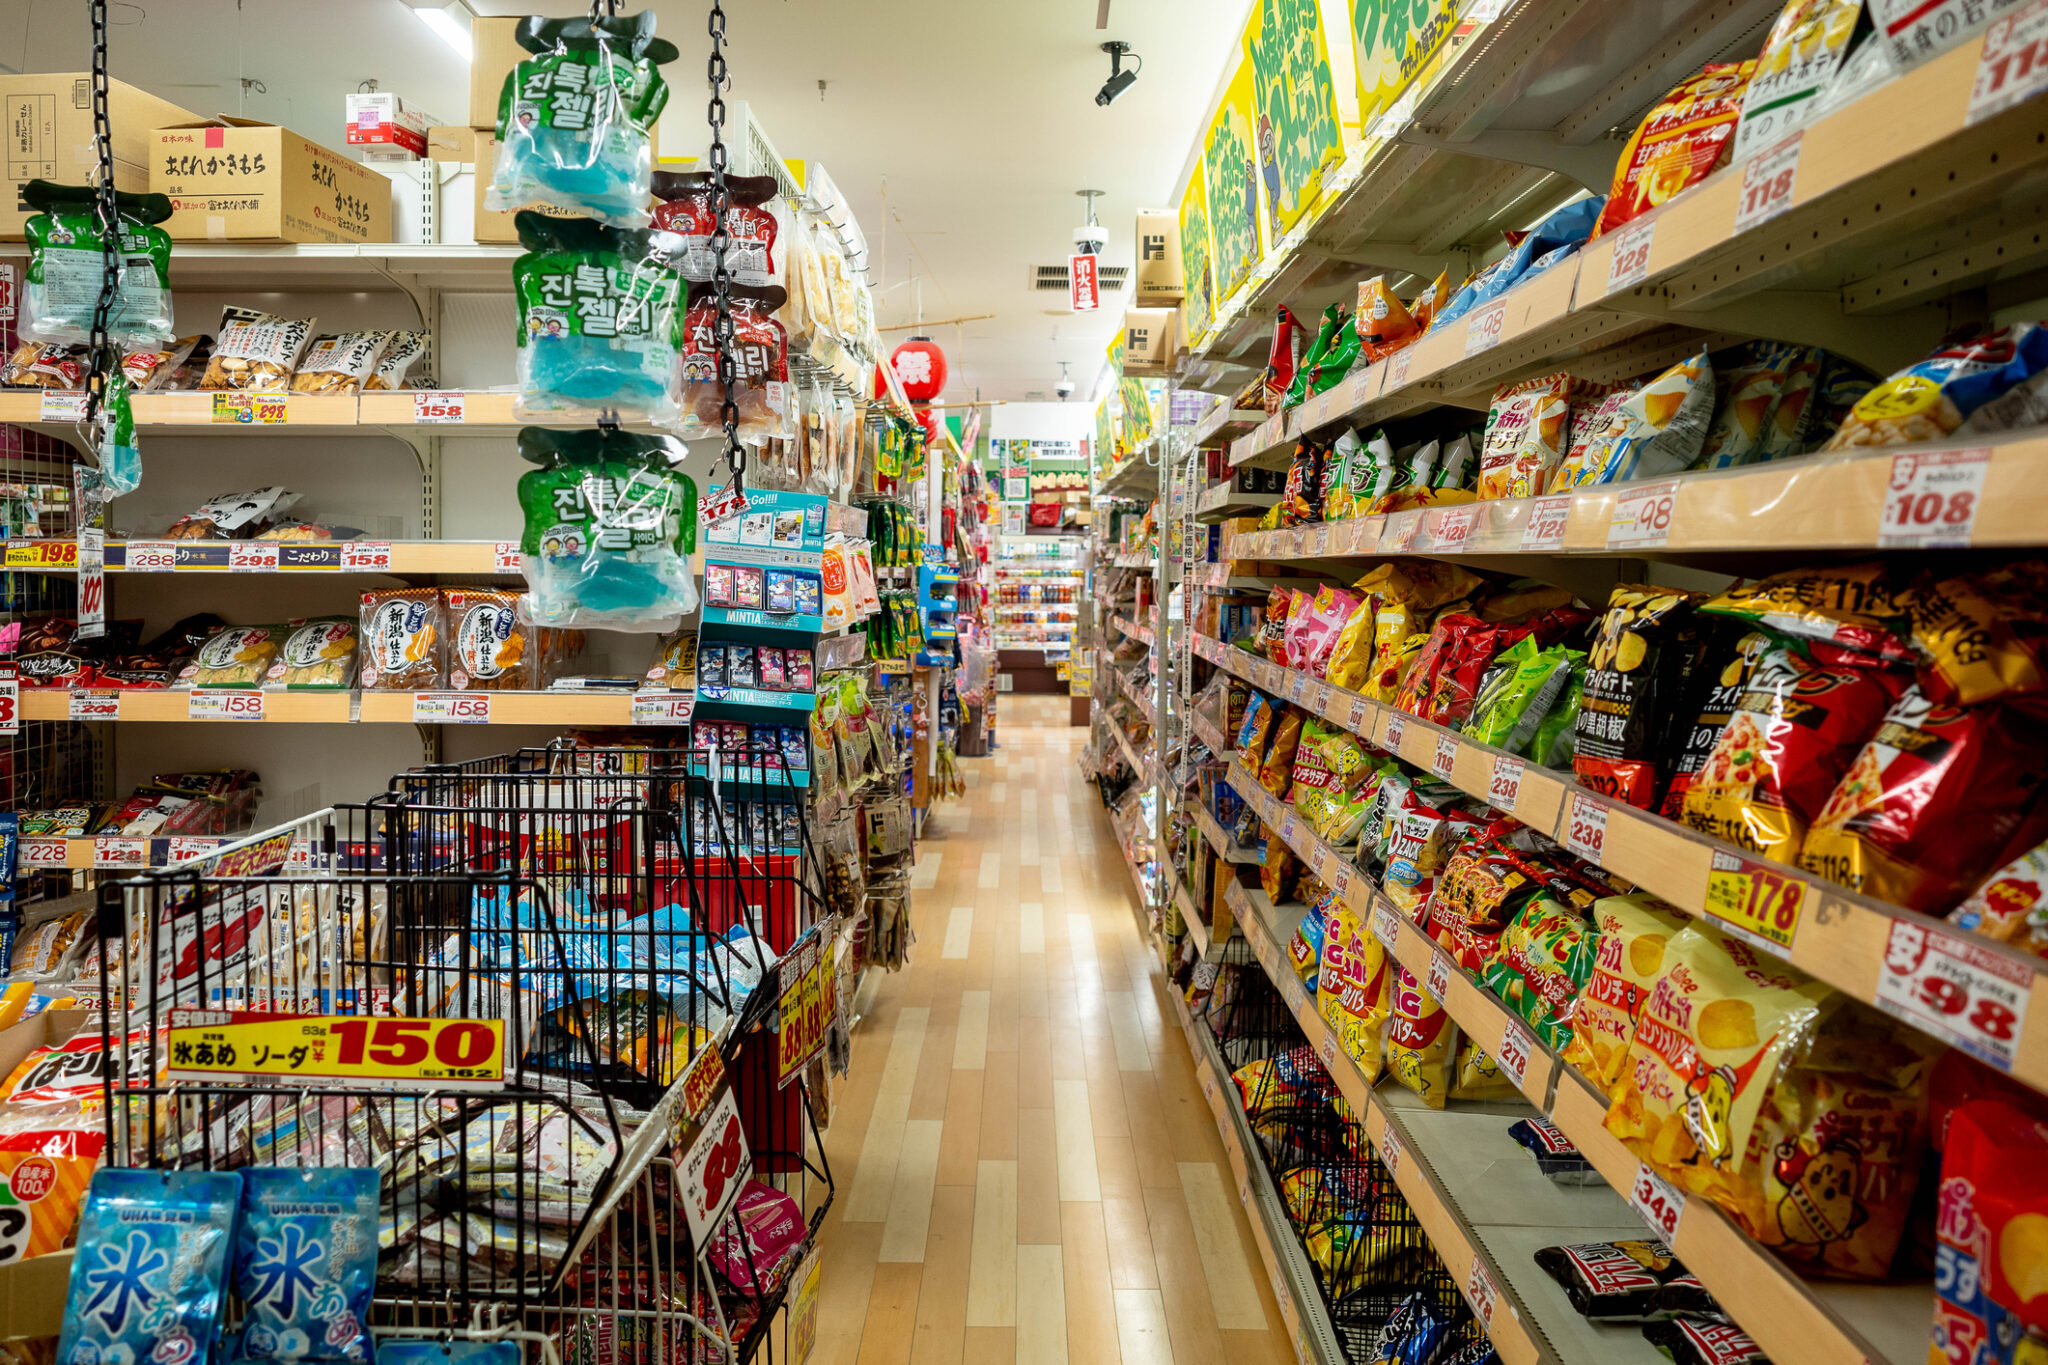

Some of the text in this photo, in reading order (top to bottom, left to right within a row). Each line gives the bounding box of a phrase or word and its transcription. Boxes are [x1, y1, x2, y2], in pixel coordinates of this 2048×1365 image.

[162, 135, 194, 144] 日本の味
[1746, 168, 1794, 214] 118
[1615, 242, 1650, 278] 128
[1075, 258, 1093, 302] 消火器
[1484, 312, 1504, 338] 98
[896, 350, 932, 385] 祭
[260, 405, 286, 418] 298
[420, 406, 462, 416] 158
[703, 494, 747, 521] 178
[1641, 497, 1673, 531] 98
[1897, 491, 1975, 526] 108
[633, 532, 656, 544] 사이다
[1184, 512, 1194, 559] 情熱価格
[1444, 525, 1467, 542] 128
[1538, 520, 1566, 538] 128
[40, 544, 77, 562] 198
[135, 554, 174, 566] 288
[234, 555, 277, 566] 298
[287, 549, 330, 563] こだわり
[347, 554, 389, 566] 158
[83, 575, 102, 616] 100
[726, 610, 761, 625] MINTIA
[388, 607, 405, 666] 新潟仕込み
[478, 611, 495, 672] 新潟仕込み
[81, 704, 118, 714] 208
[224, 696, 263, 713] 158
[451, 701, 489, 717] 158
[755, 691, 793, 702] BREEZE
[1318, 696, 1328, 710] 118
[1350, 711, 1363, 726] 108
[1387, 727, 1401, 745] 108
[1436, 751, 1455, 773] 118
[1492, 776, 1519, 800] 238
[1571, 820, 1604, 850] 238
[30, 845, 67, 861] 228
[100, 850, 142, 861] 128
[1312, 853, 1324, 870] 108
[1400, 837, 1423, 863] ZACK
[1336, 874, 1348, 888] 138
[1747, 868, 1800, 933] 178
[173, 904, 264, 981] 88
[1385, 917, 1399, 944] 108
[1520, 898, 1583, 965] じゃがりこ
[1889, 921, 1922, 971] 安
[1430, 970, 1448, 996] 148
[806, 1000, 822, 1040] 88
[1919, 975, 2019, 1044] 98
[1587, 1008, 1627, 1040] PACK
[330, 1019, 496, 1068] 150
[784, 1013, 801, 1063] 88
[174, 1040, 310, 1070] 氷あめ ソーダ
[1501, 1039, 1527, 1075] 278
[703, 1114, 742, 1211] 88
[1384, 1140, 1399, 1174] 278
[18, 1166, 51, 1180] 国産米
[121, 1209, 194, 1225] UHA味覚糖
[271, 1203, 341, 1215] UHA味覚糖
[1637, 1179, 1680, 1235] 348
[1470, 1279, 1493, 1323] 278
